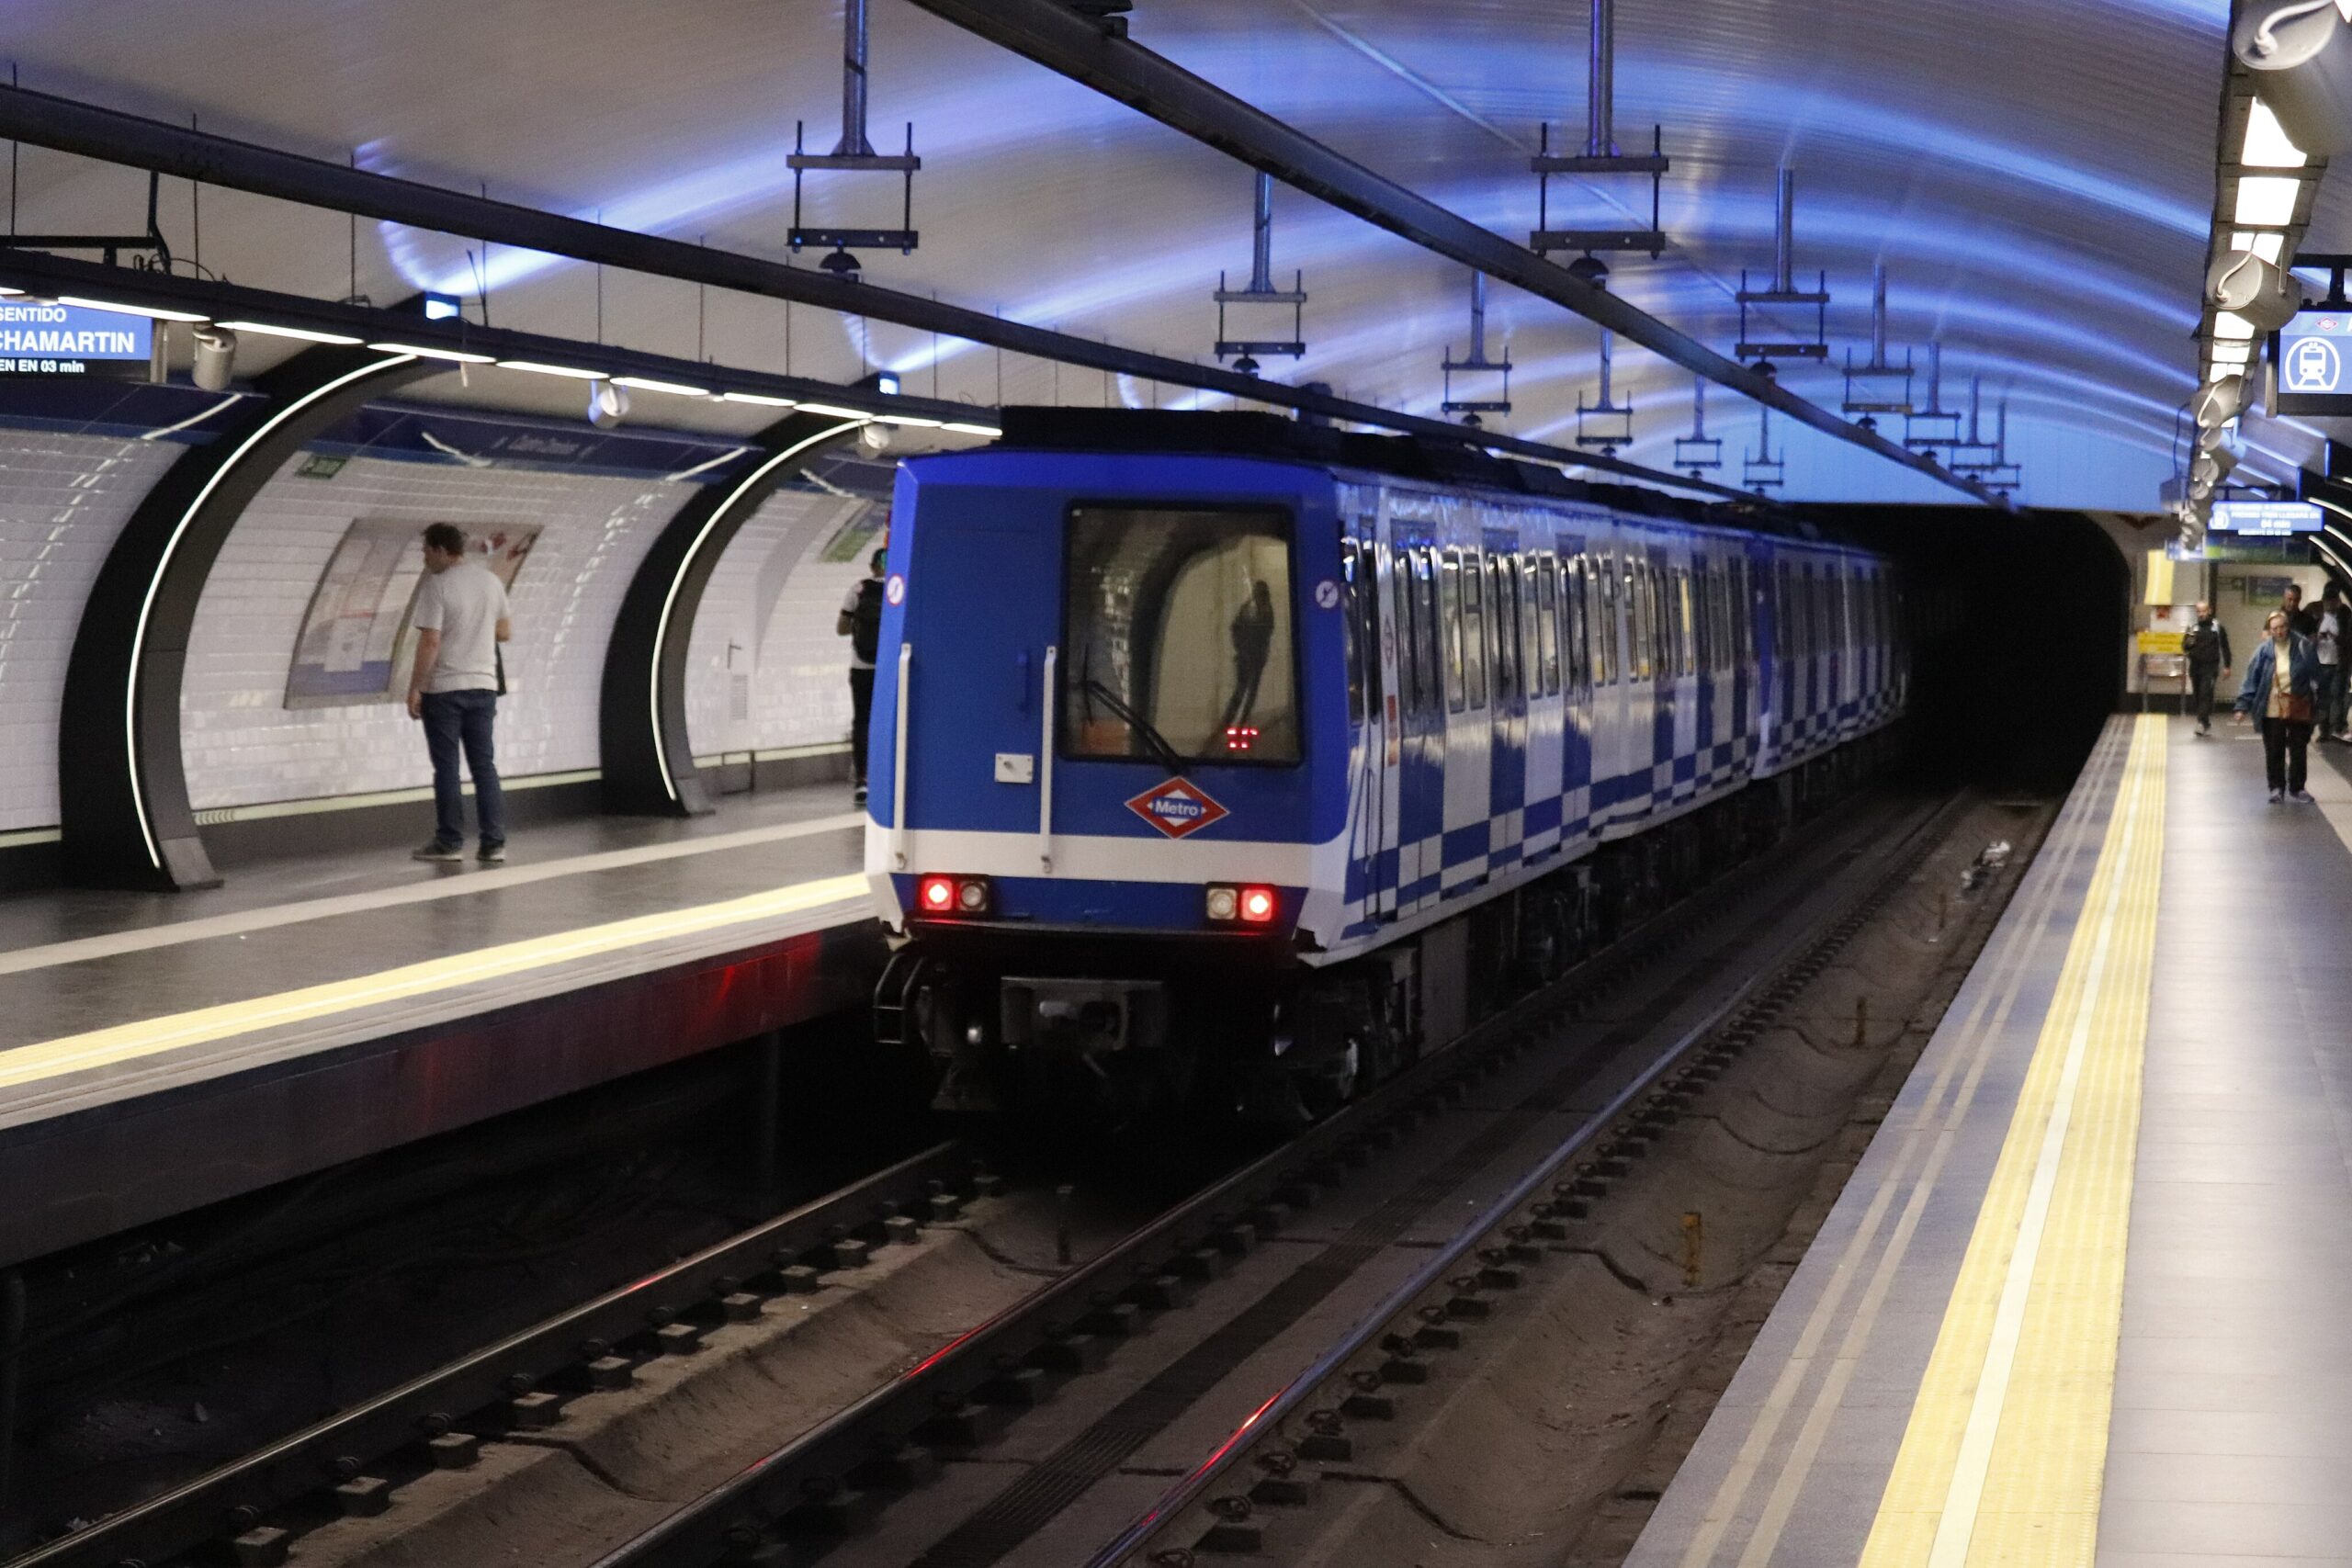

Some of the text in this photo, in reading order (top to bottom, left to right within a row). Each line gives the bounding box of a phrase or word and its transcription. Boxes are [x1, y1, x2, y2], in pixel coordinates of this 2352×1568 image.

[0, 331, 135, 353] HAMARTIN
[18, 359, 38, 372] EN
[40, 359, 57, 373] 03
[59, 360, 85, 373] min
[1155, 800, 1198, 817] Metro
